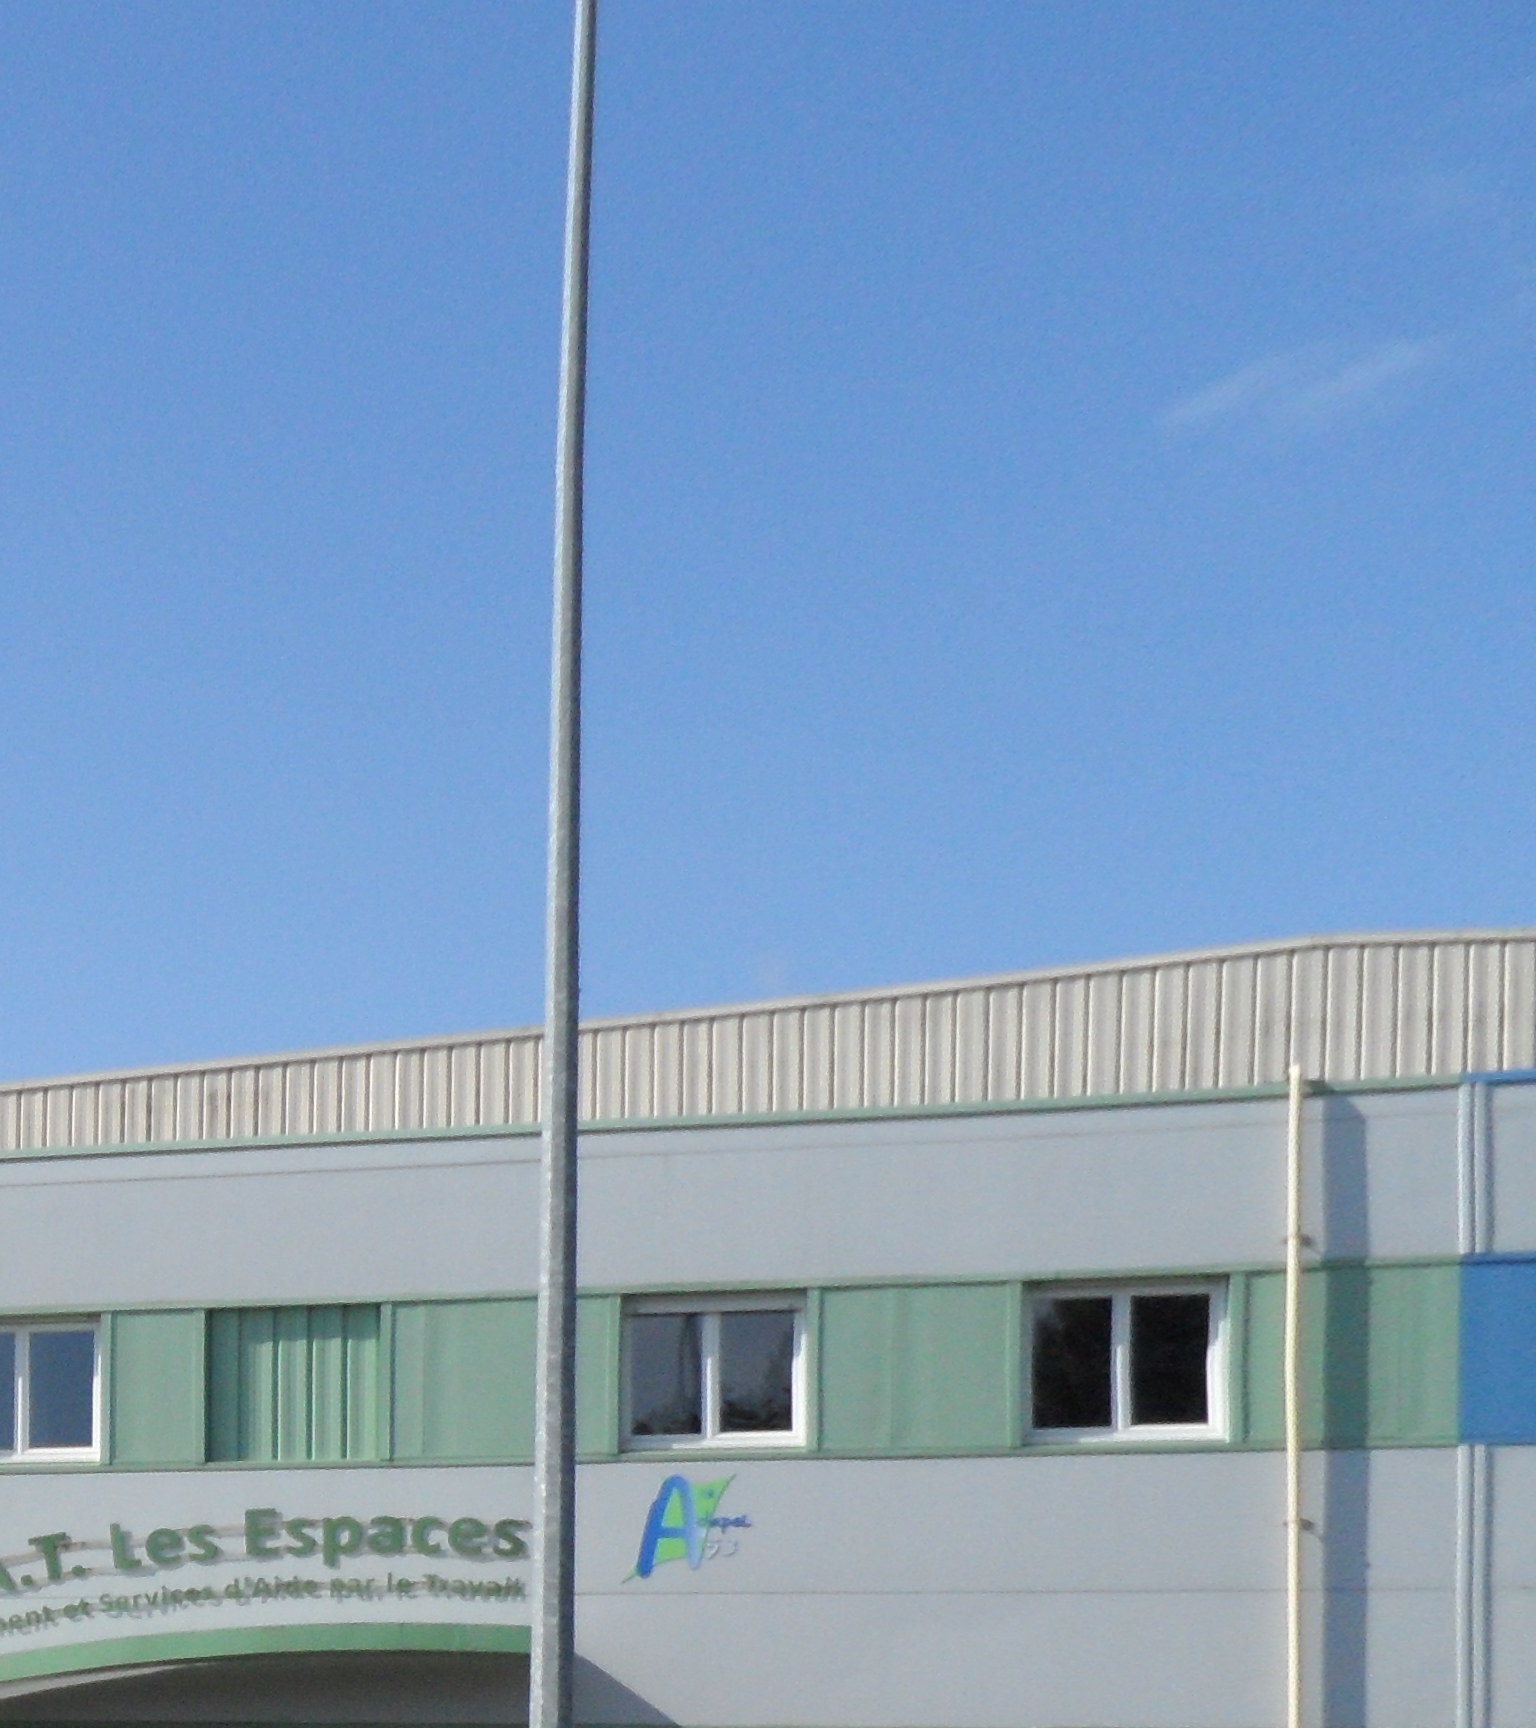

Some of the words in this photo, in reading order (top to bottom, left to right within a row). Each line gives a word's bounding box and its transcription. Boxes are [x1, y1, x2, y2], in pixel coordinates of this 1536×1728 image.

[109, 1522, 220, 1563] Les
[244, 1508, 531, 1569] Espaces
[62, 1597, 91, 1619] et
[98, 1584, 216, 1611] Services
[387, 1572, 416, 1595] le
